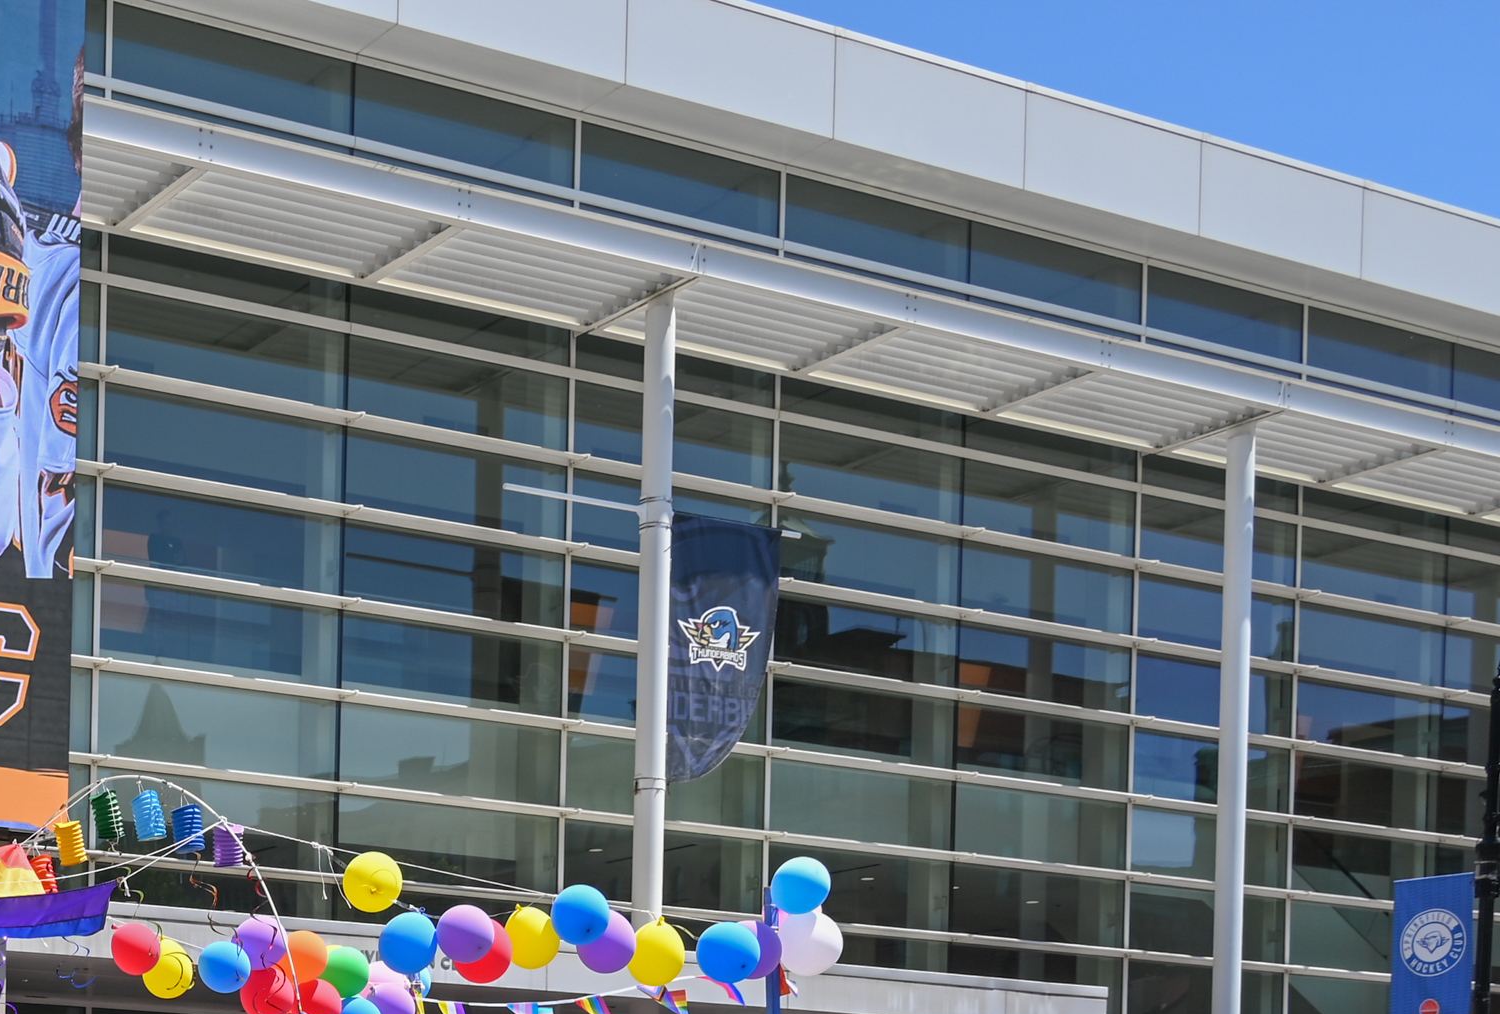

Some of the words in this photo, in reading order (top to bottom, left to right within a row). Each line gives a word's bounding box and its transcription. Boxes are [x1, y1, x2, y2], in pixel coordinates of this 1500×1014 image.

[691, 646, 745, 666] THUNDERBIRDS
[1403, 911, 1453, 952] SPRINGFIELD
[1409, 958, 1449, 974] HOCKEY
[1449, 932, 1464, 960] CLUB
